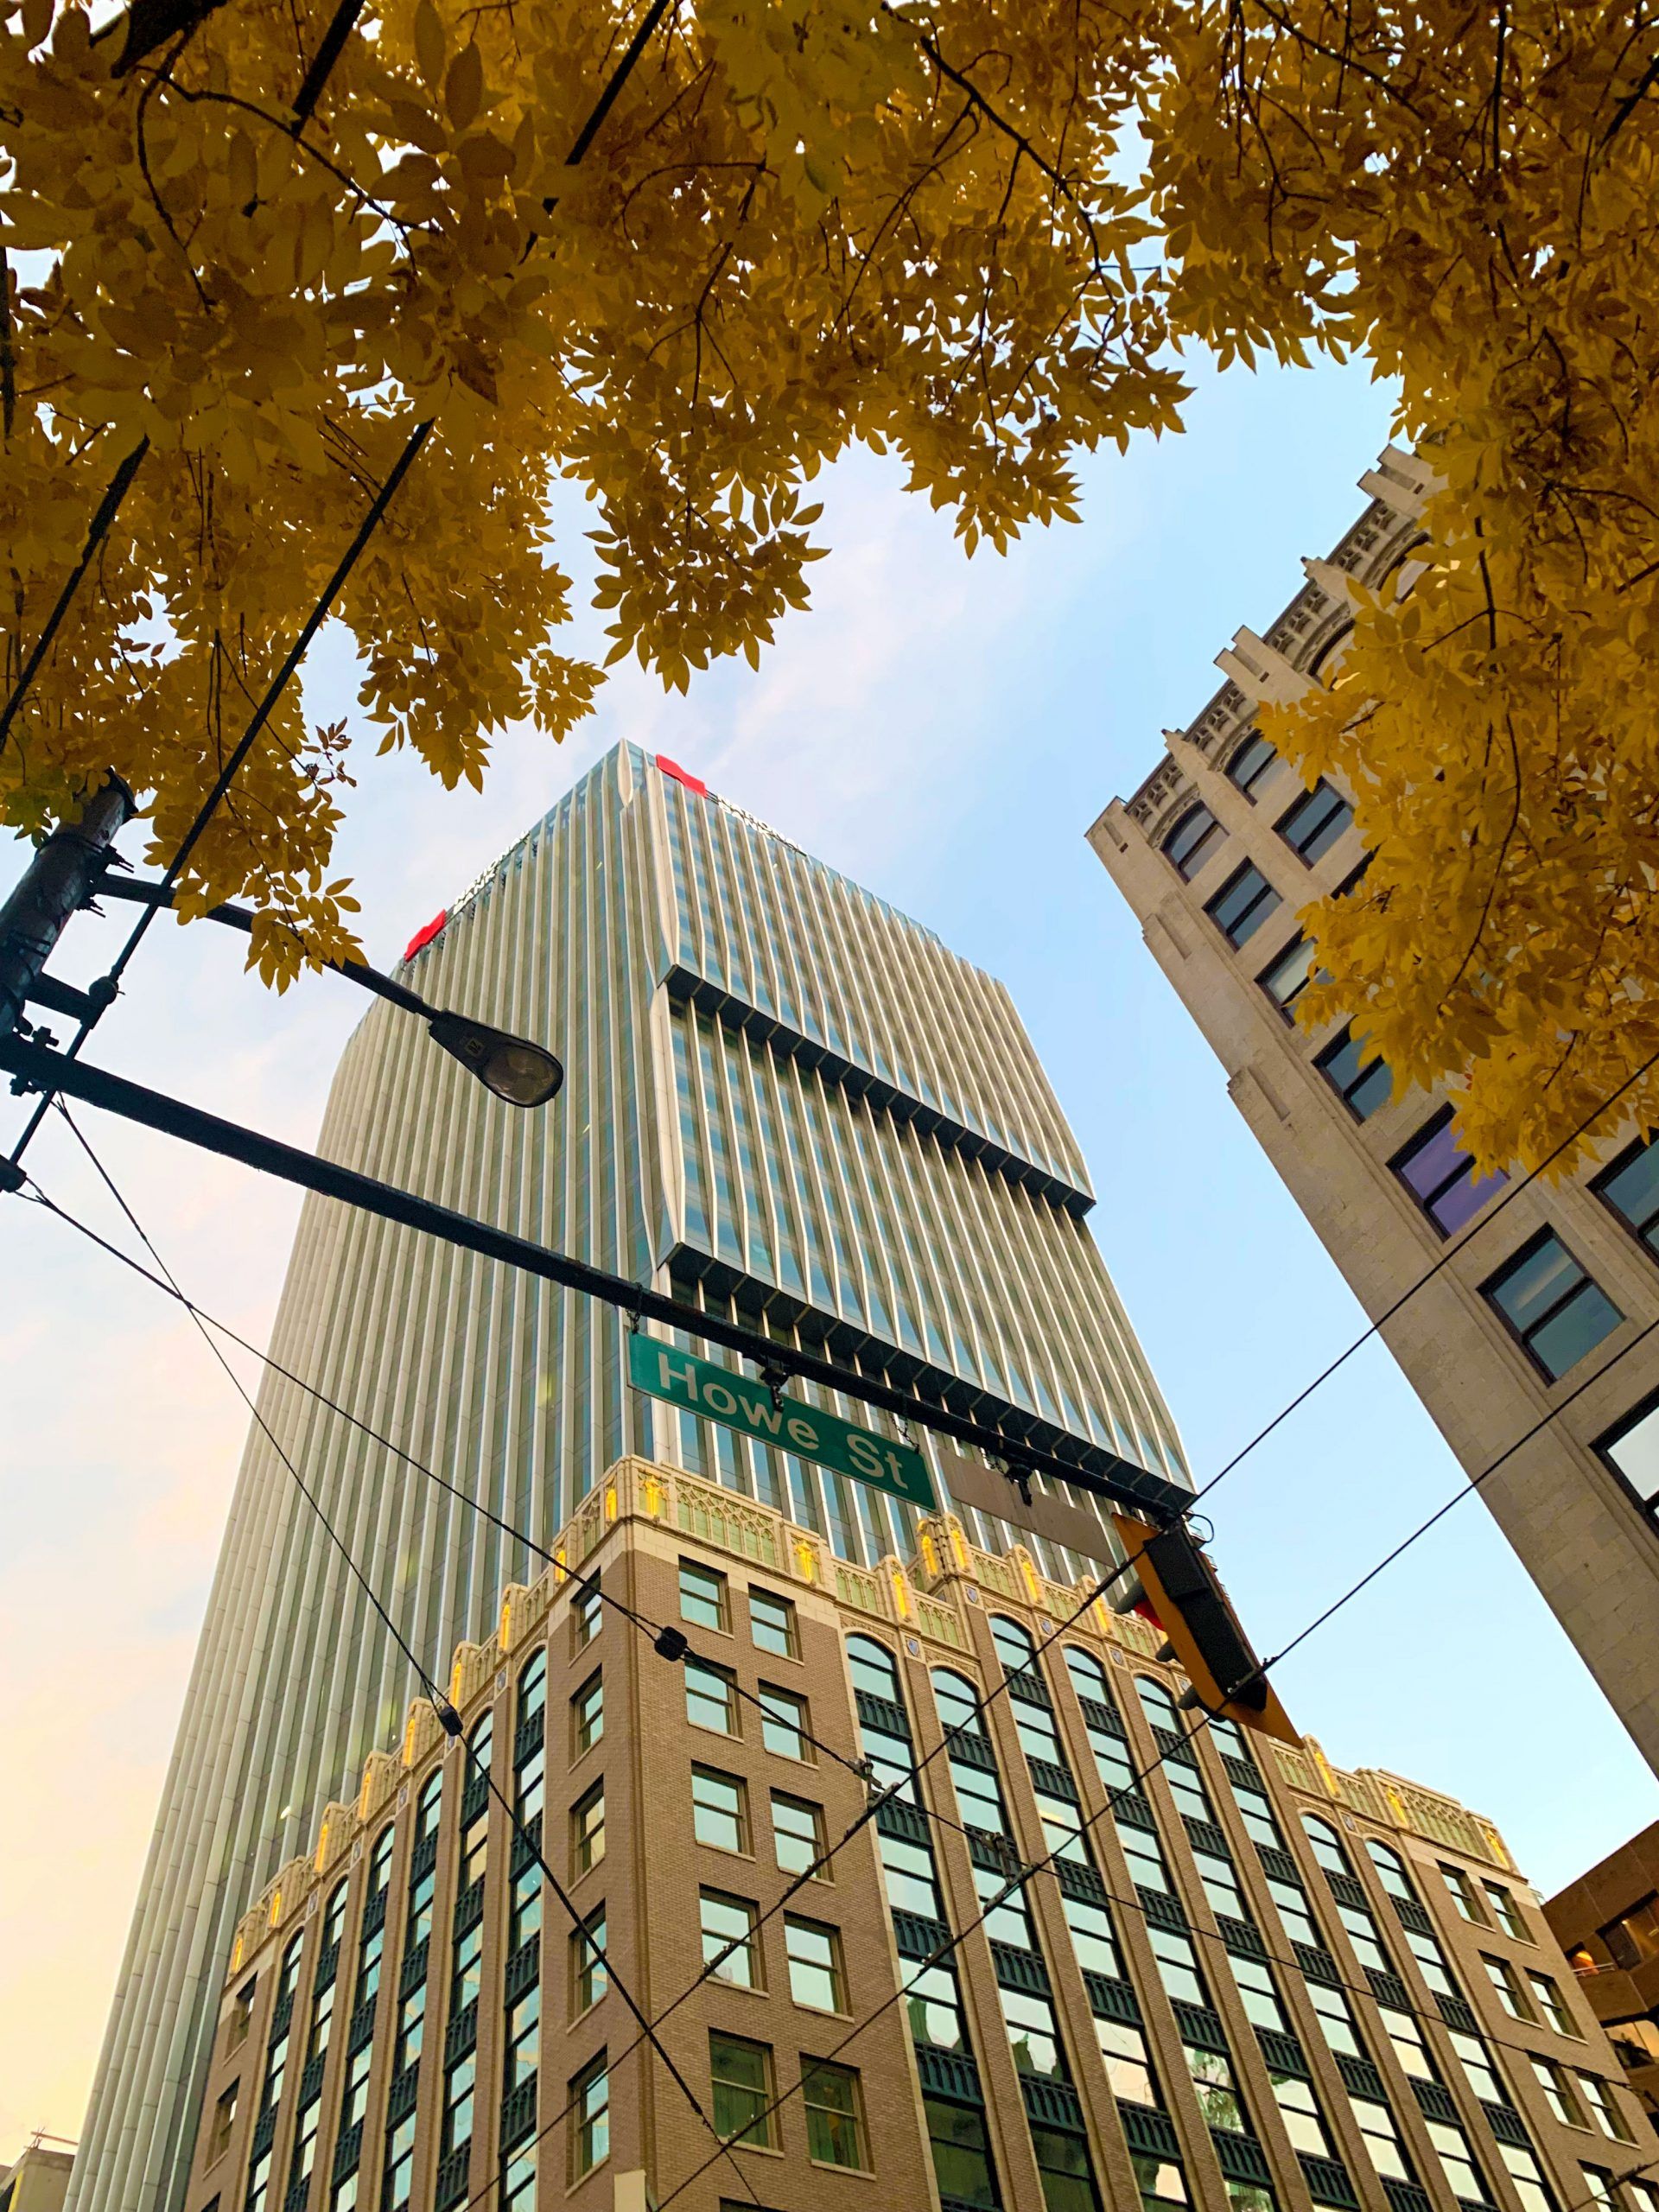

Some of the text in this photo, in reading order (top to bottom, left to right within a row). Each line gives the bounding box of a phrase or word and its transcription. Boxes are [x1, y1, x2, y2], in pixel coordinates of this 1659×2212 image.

[454, 830, 530, 906] NATIONAL
[454, 871, 495, 915] BANK
[658, 1351, 908, 1489] Howe St
